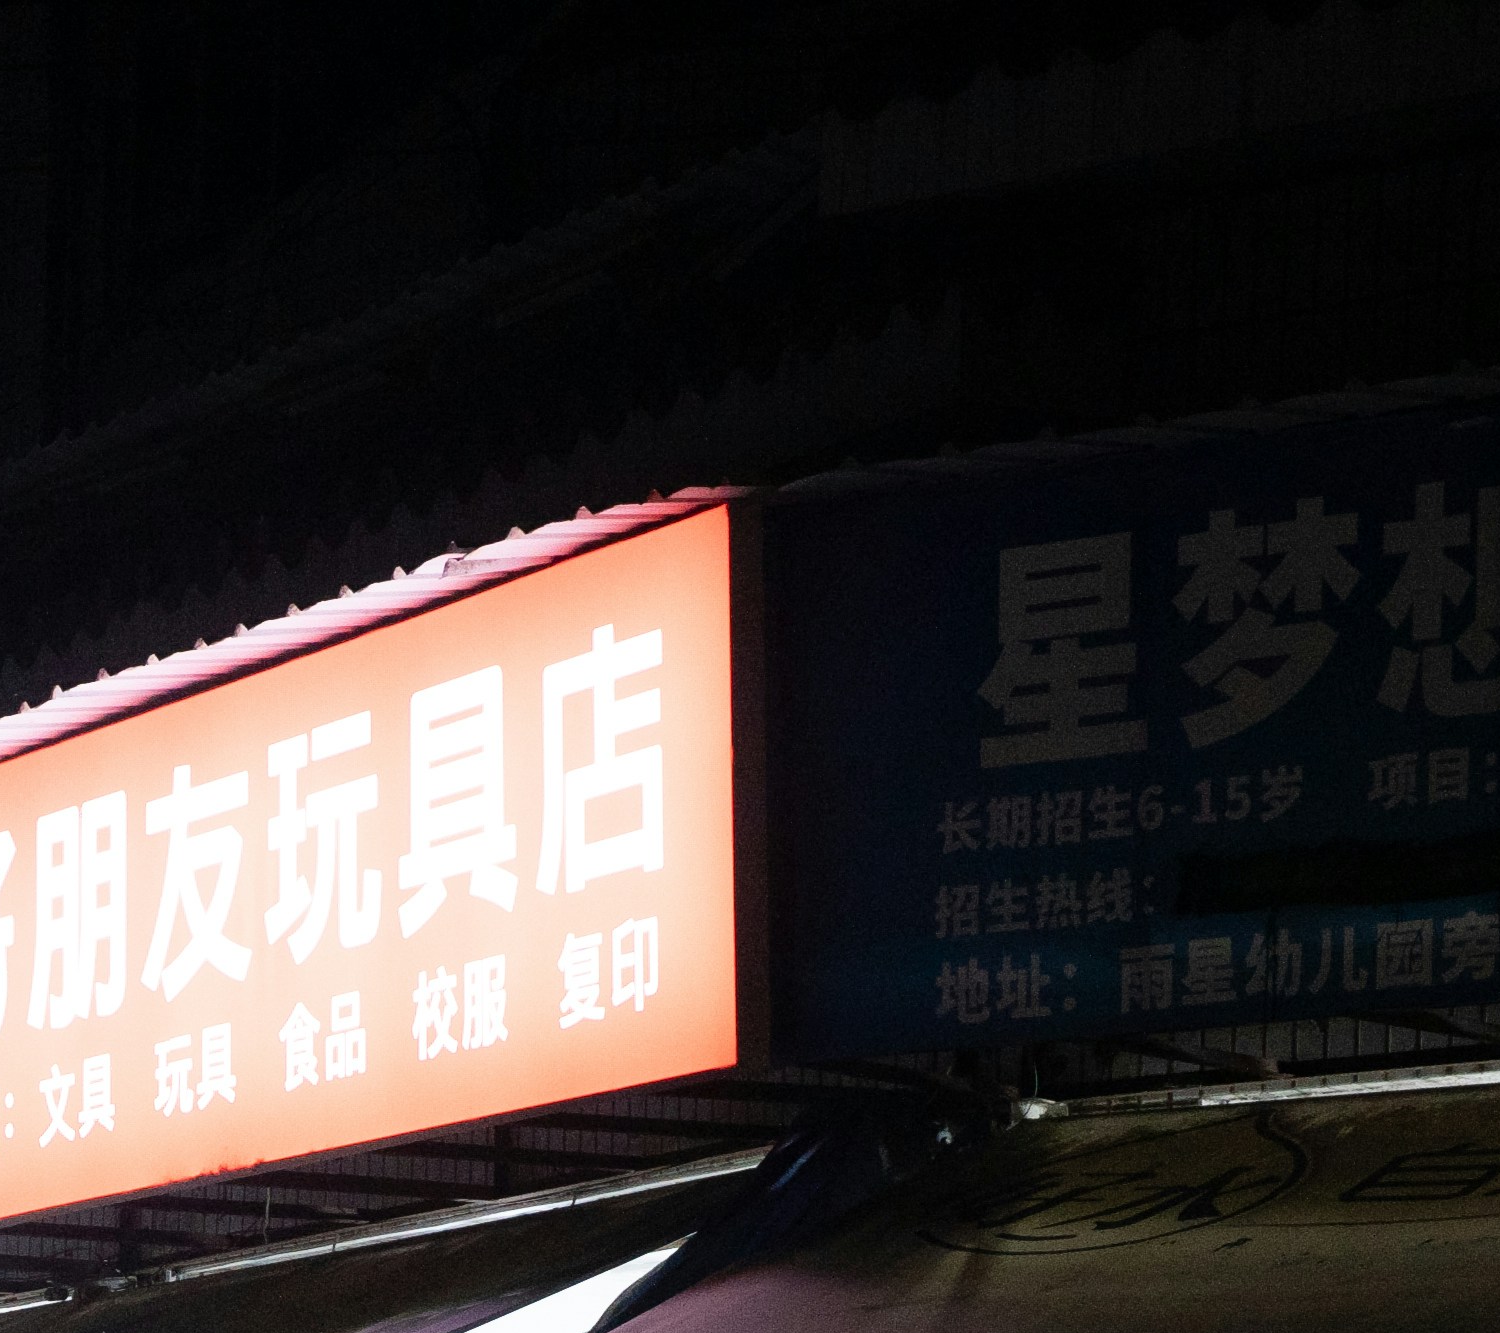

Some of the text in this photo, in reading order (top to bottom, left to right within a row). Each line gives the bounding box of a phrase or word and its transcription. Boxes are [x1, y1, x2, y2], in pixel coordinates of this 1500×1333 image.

[935, 765, 1305, 855] 长期招生6-15岁
[39, 1051, 117, 1147] 文具
[152, 1018, 237, 1114] 玩具
[277, 987, 367, 1092] 食品
[412, 956, 509, 1062] 校服
[556, 916, 660, 1032] 复印
